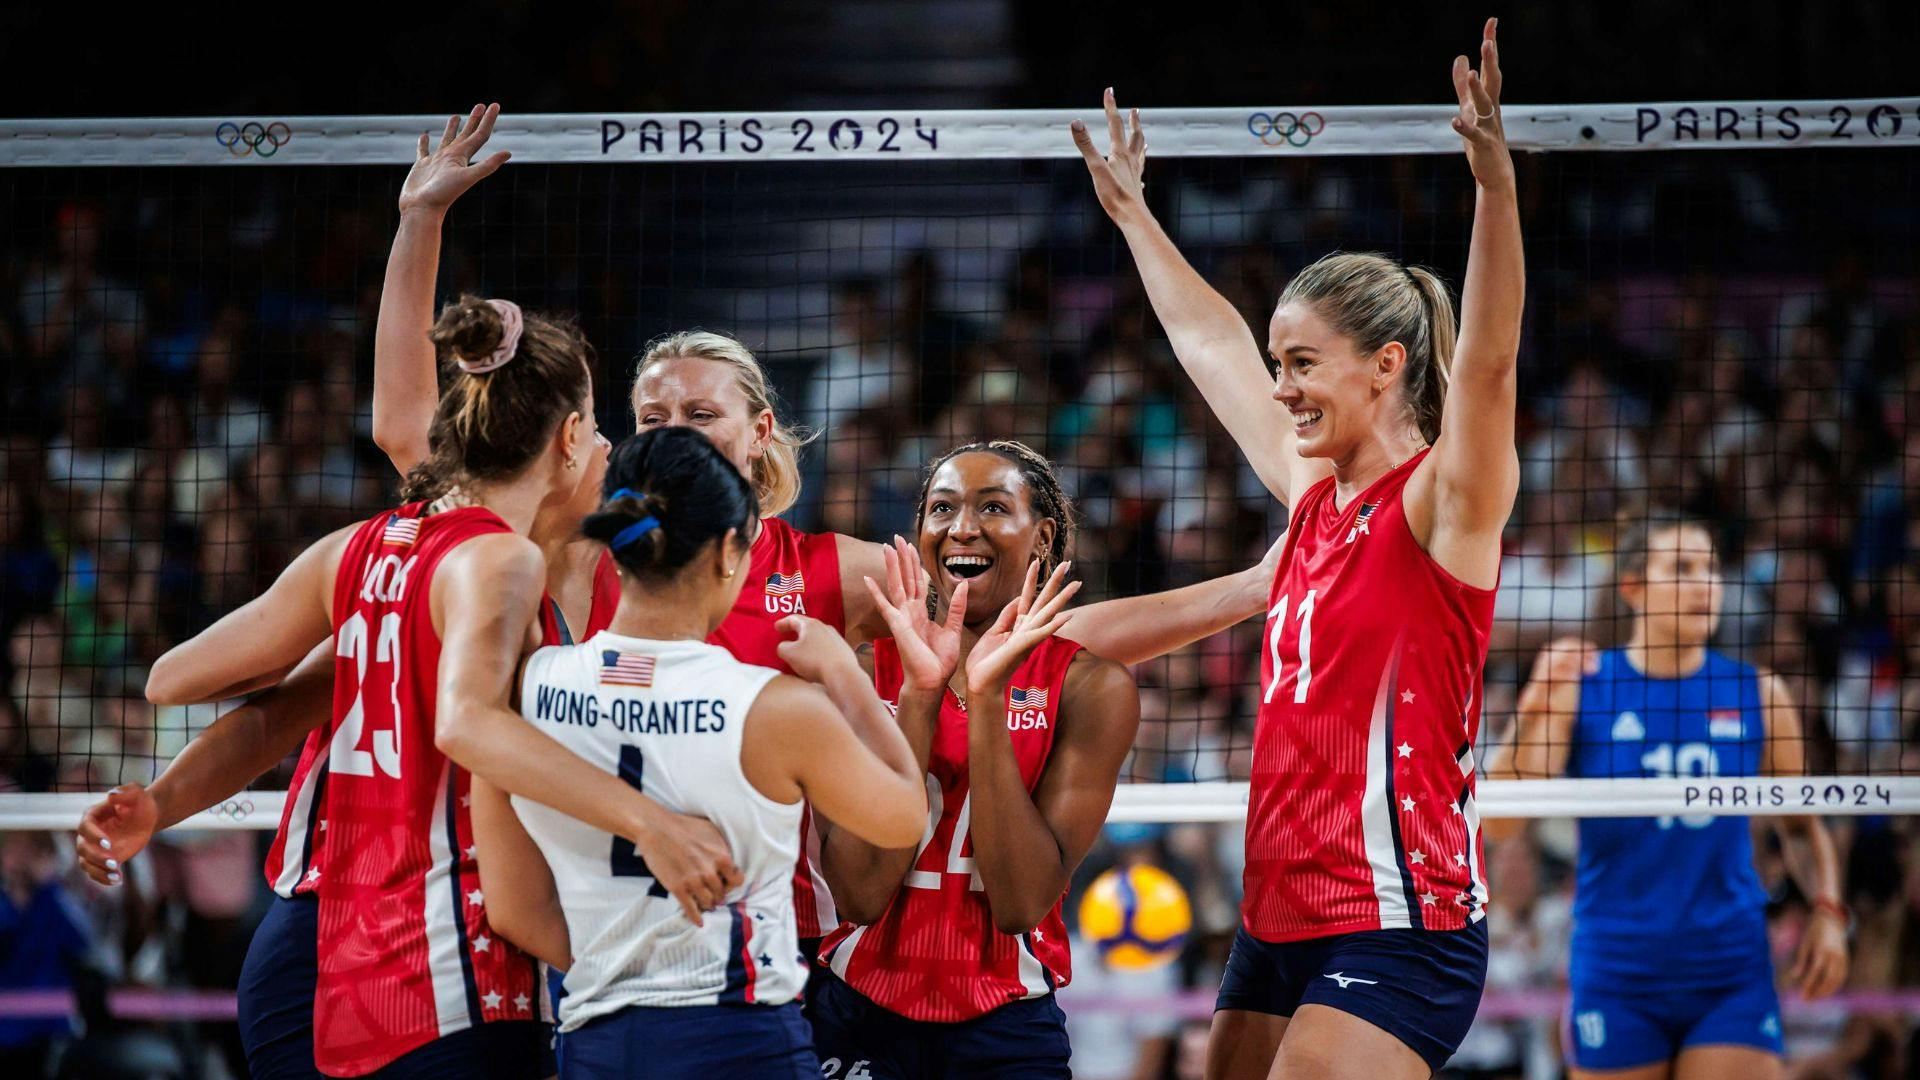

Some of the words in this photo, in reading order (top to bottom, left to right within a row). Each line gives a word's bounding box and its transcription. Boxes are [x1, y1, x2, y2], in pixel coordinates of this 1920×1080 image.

[790, 117, 939, 153] 2024
[1829, 104, 1920, 139] 20
[764, 593, 806, 615] USA
[1264, 589, 1318, 704] 11
[328, 609, 402, 780] 23
[535, 683, 727, 734] WONG-ORANTES
[1006, 709, 1049, 731] USA
[1801, 784, 1891, 805] 2024
